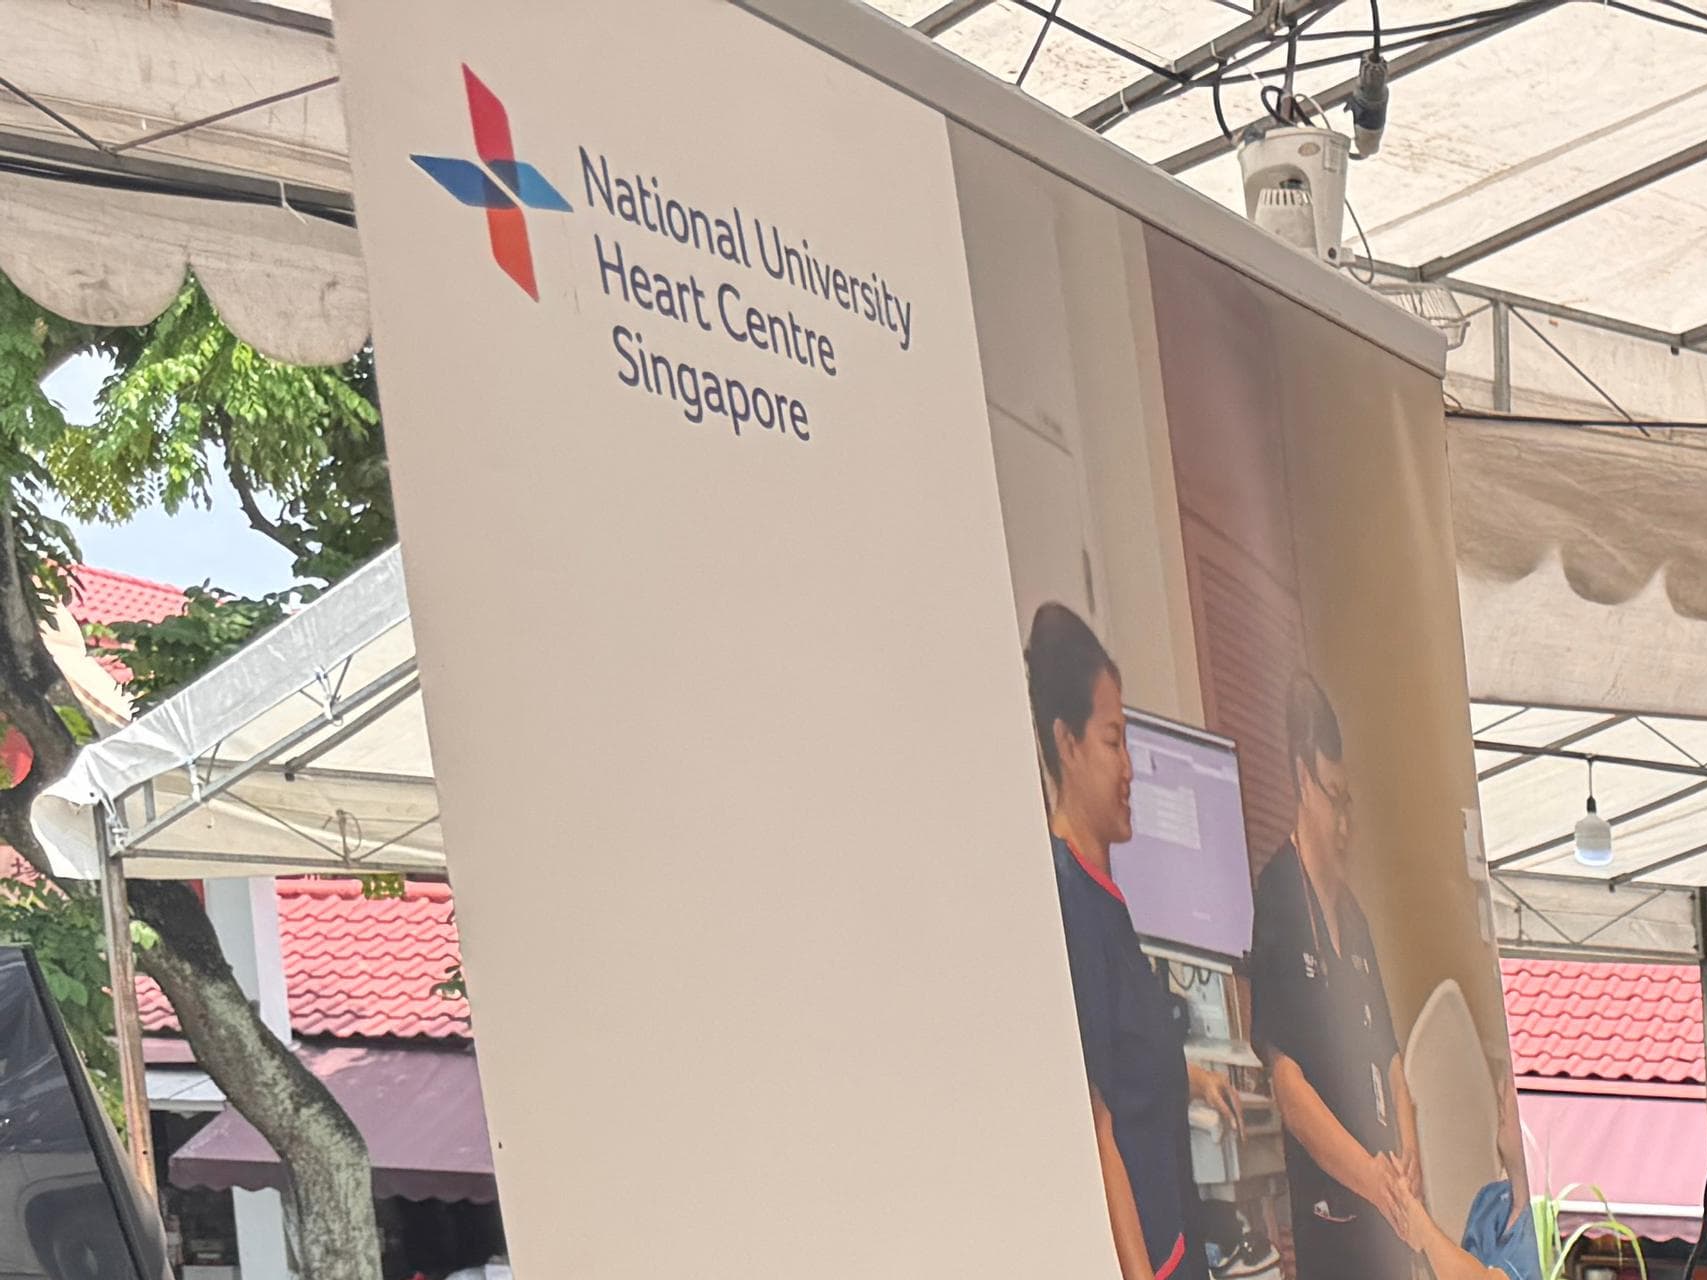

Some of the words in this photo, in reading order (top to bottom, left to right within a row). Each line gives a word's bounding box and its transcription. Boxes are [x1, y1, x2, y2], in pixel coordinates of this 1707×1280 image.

[578, 145, 749, 269] National
[754, 217, 912, 350] University
[594, 234, 711, 331] Heart
[717, 284, 837, 377] Centre
[611, 324, 811, 442] Singapore
